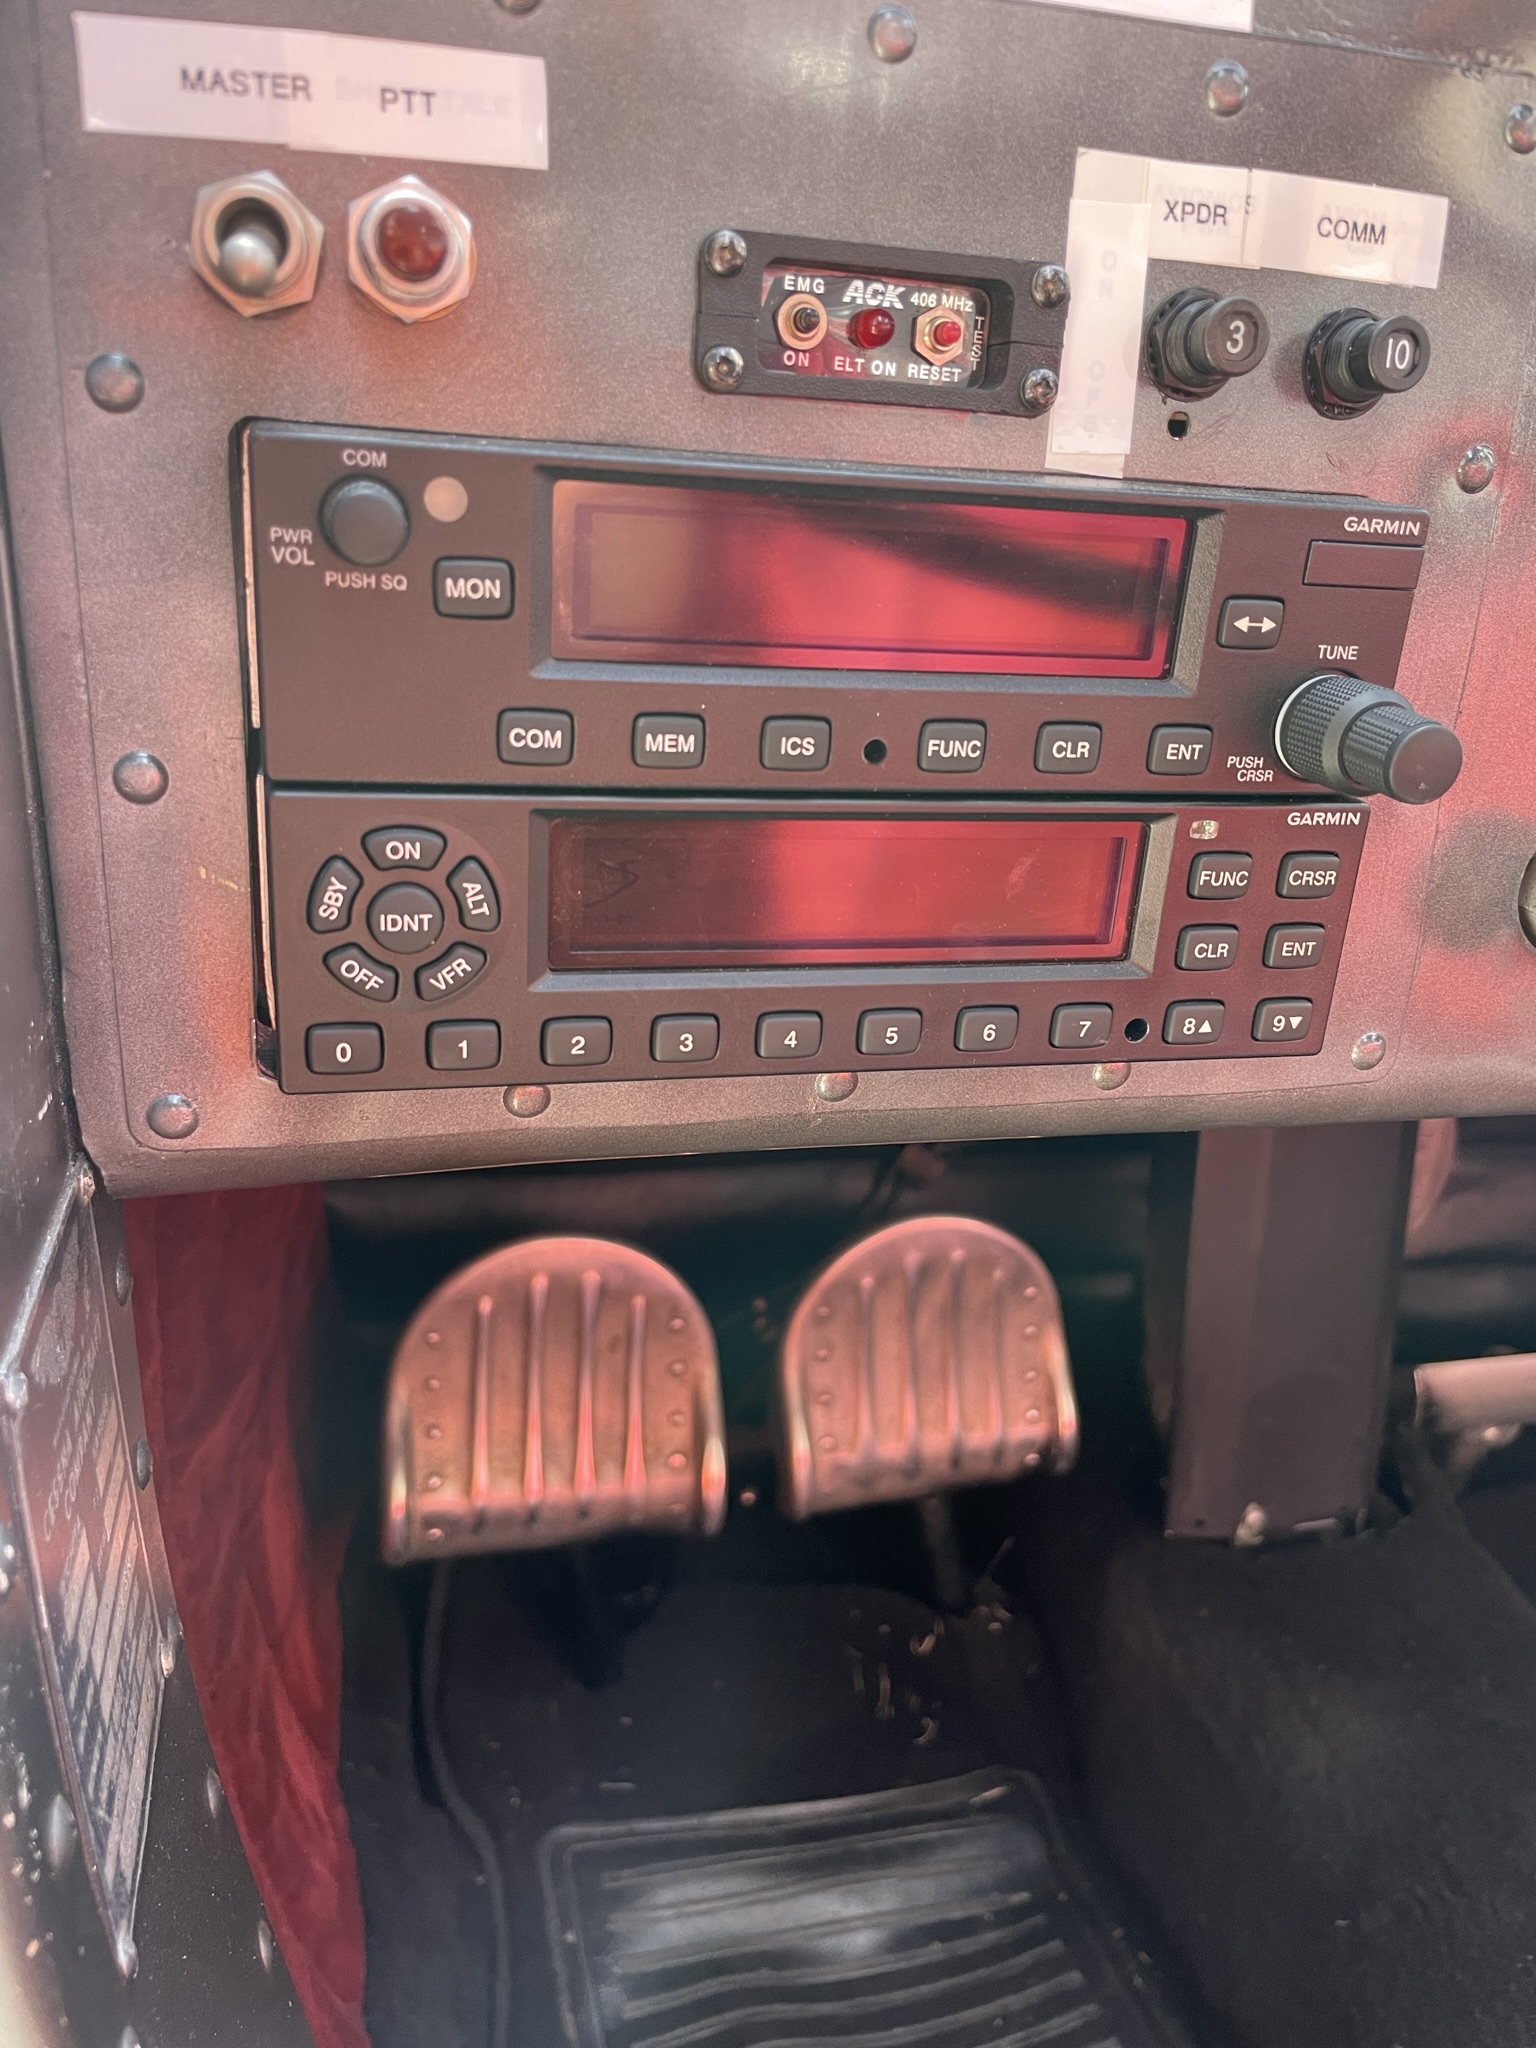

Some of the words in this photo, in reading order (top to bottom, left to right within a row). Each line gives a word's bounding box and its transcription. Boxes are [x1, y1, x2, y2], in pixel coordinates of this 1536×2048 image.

[180, 65, 312, 101] MASTER
[380, 86, 437, 117] PTT
[1162, 199, 1228, 227] XPDR
[1317, 216, 1386, 246] COMM
[784, 275, 825, 294] EMG
[842, 279, 906, 309] ACK
[910, 291, 937, 308] 406
[942, 294, 973, 312] MHz
[970, 316, 985, 371] TEST
[1226, 320, 1245, 354] 3
[783, 351, 810, 367] ON
[1386, 338, 1409, 369] 10
[834, 356, 865, 373] ELT
[871, 360, 897, 377] ON
[908, 364, 962, 382] RESET
[343, 450, 387, 468] COM
[270, 527, 313, 545] PWR
[1343, 516, 1420, 536] GARMIN
[271, 547, 315, 566] VOL
[325, 571, 376, 589] PUSH
[381, 574, 408, 591] SQ
[445, 577, 501, 599] MON
[1318, 644, 1359, 660] TUNE
[508, 728, 562, 749] COM
[645, 733, 695, 754] MEM
[780, 736, 815, 756] ICS
[927, 739, 982, 758] FUNC
[1052, 741, 1090, 758] CLR
[1166, 743, 1203, 761] ENT
[1227, 756, 1263, 769] PUSH
[1237, 769, 1274, 782] CRSR
[1287, 812, 1361, 826] GARMIN
[385, 840, 421, 860] ON
[1199, 870, 1249, 886] FUNC
[1288, 870, 1337, 886] CRSR
[318, 876, 348, 920] SBY
[462, 882, 490, 916] ALT
[379, 913, 433, 932] IDNT
[1194, 943, 1229, 958] CLR
[1281, 941, 1317, 957] ENT
[340, 959, 385, 990] OFF
[429, 957, 472, 990] VFR
[982, 1024, 997, 1042] 6
[1078, 1021, 1093, 1038] 7
[1183, 1017, 1197, 1035] 8
[1272, 1014, 1287, 1032] 9
[570, 1036, 586, 1056] 2
[679, 1033, 694, 1052] 3
[784, 1030, 798, 1049] 4
[884, 1027, 899, 1045] 5
[335, 1042, 352, 1063] 0
[457, 1039, 469, 1059] 1
[42, 1425, 73, 1549] CESSNA
[72, 1310, 103, 1433] AIRCRAFT
[63, 1386, 96, 1525] COMPANY
